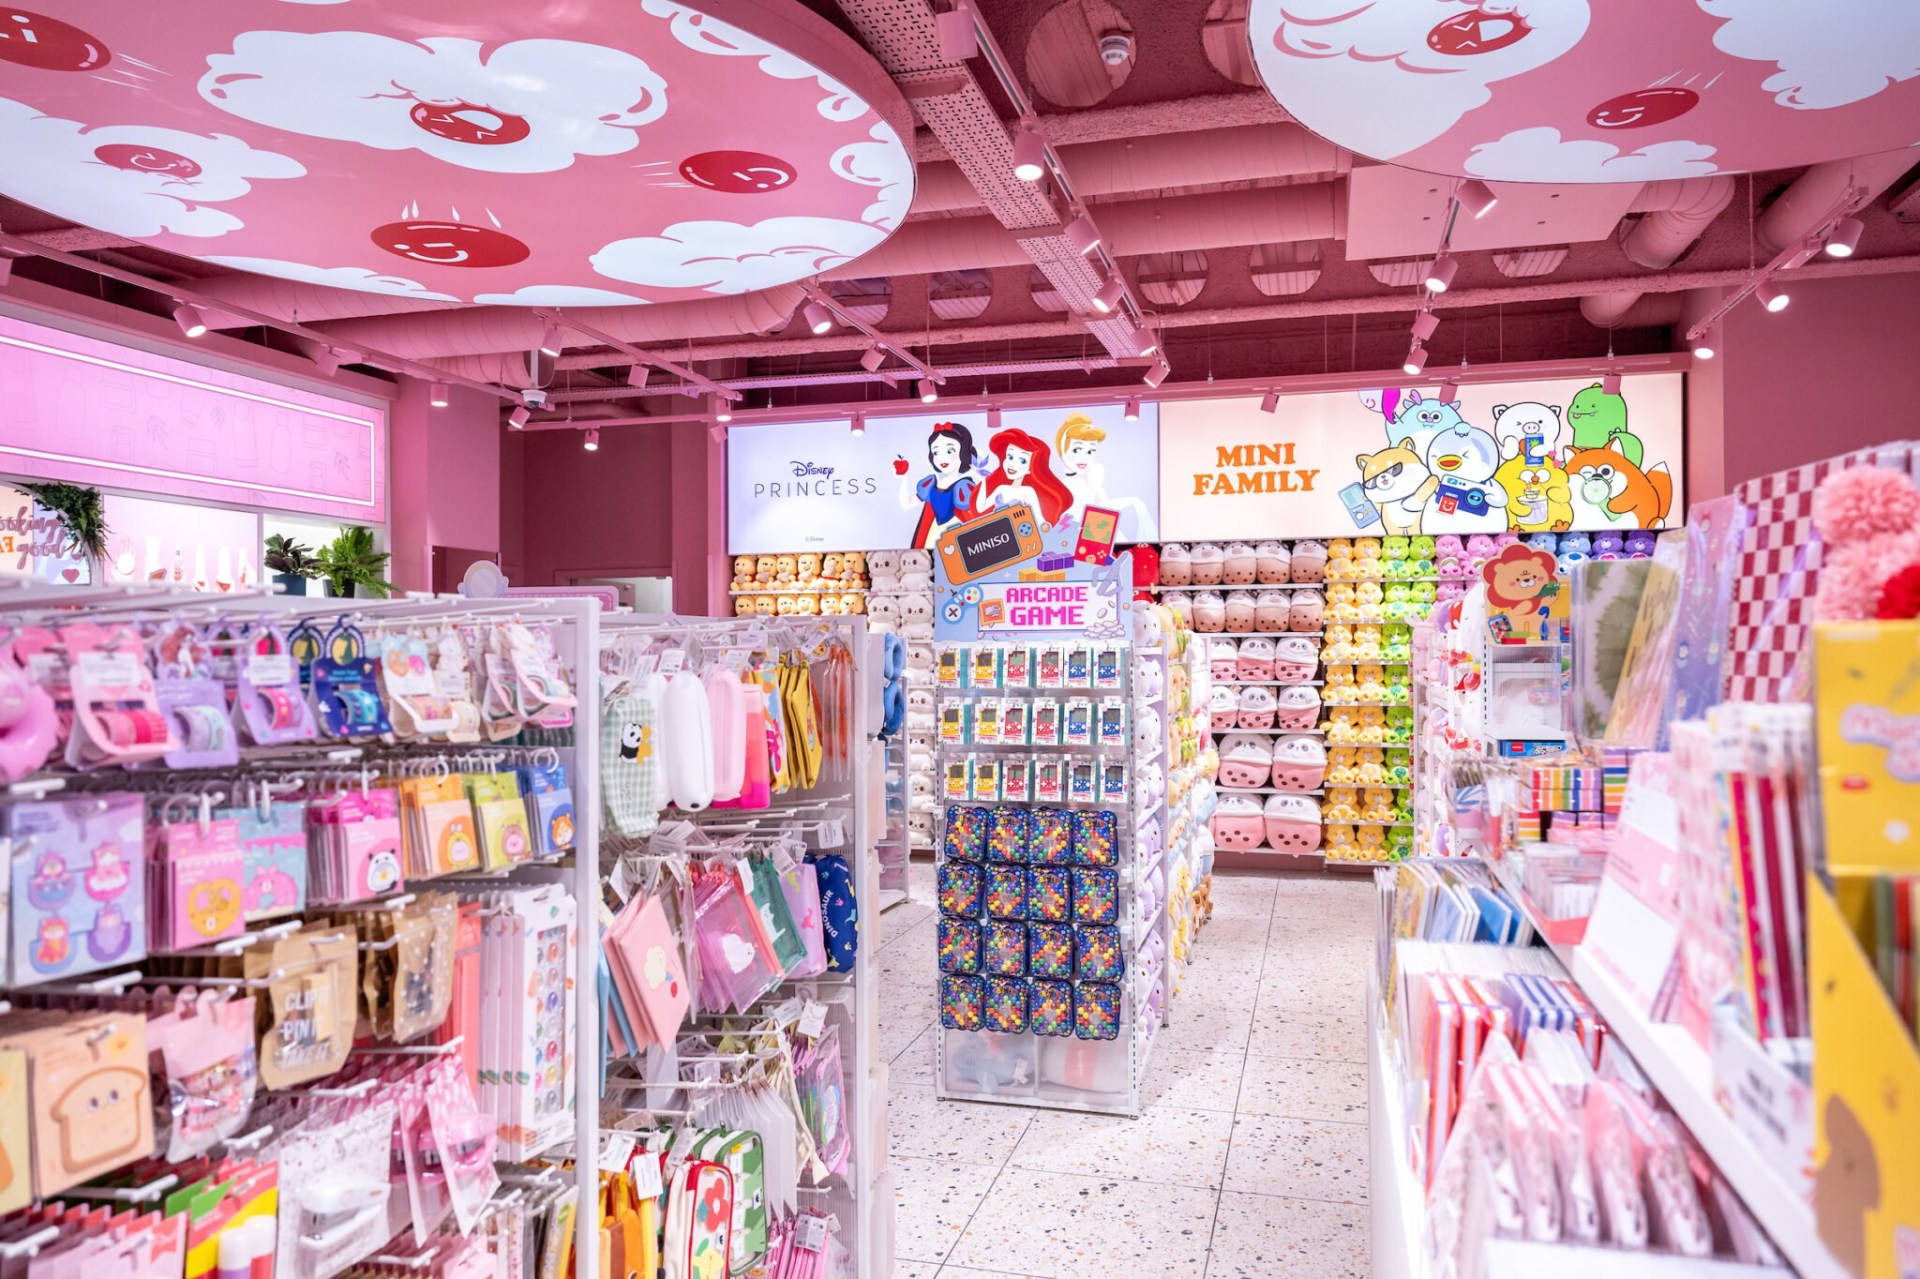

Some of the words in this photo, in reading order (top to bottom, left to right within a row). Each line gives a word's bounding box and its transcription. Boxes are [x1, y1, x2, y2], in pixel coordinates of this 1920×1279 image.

[1216, 442, 1296, 468] MINI
[789, 460, 835, 480] Disney
[1193, 469, 1321, 496] FAMILY
[754, 477, 877, 499] PRINCESS
[16, 528, 67, 570] good
[967, 532, 1010, 557] MINISO
[1006, 586, 1088, 603] ARCADE
[1010, 605, 1085, 626] GAME
[821, 889, 839, 939] DINOSAUR
